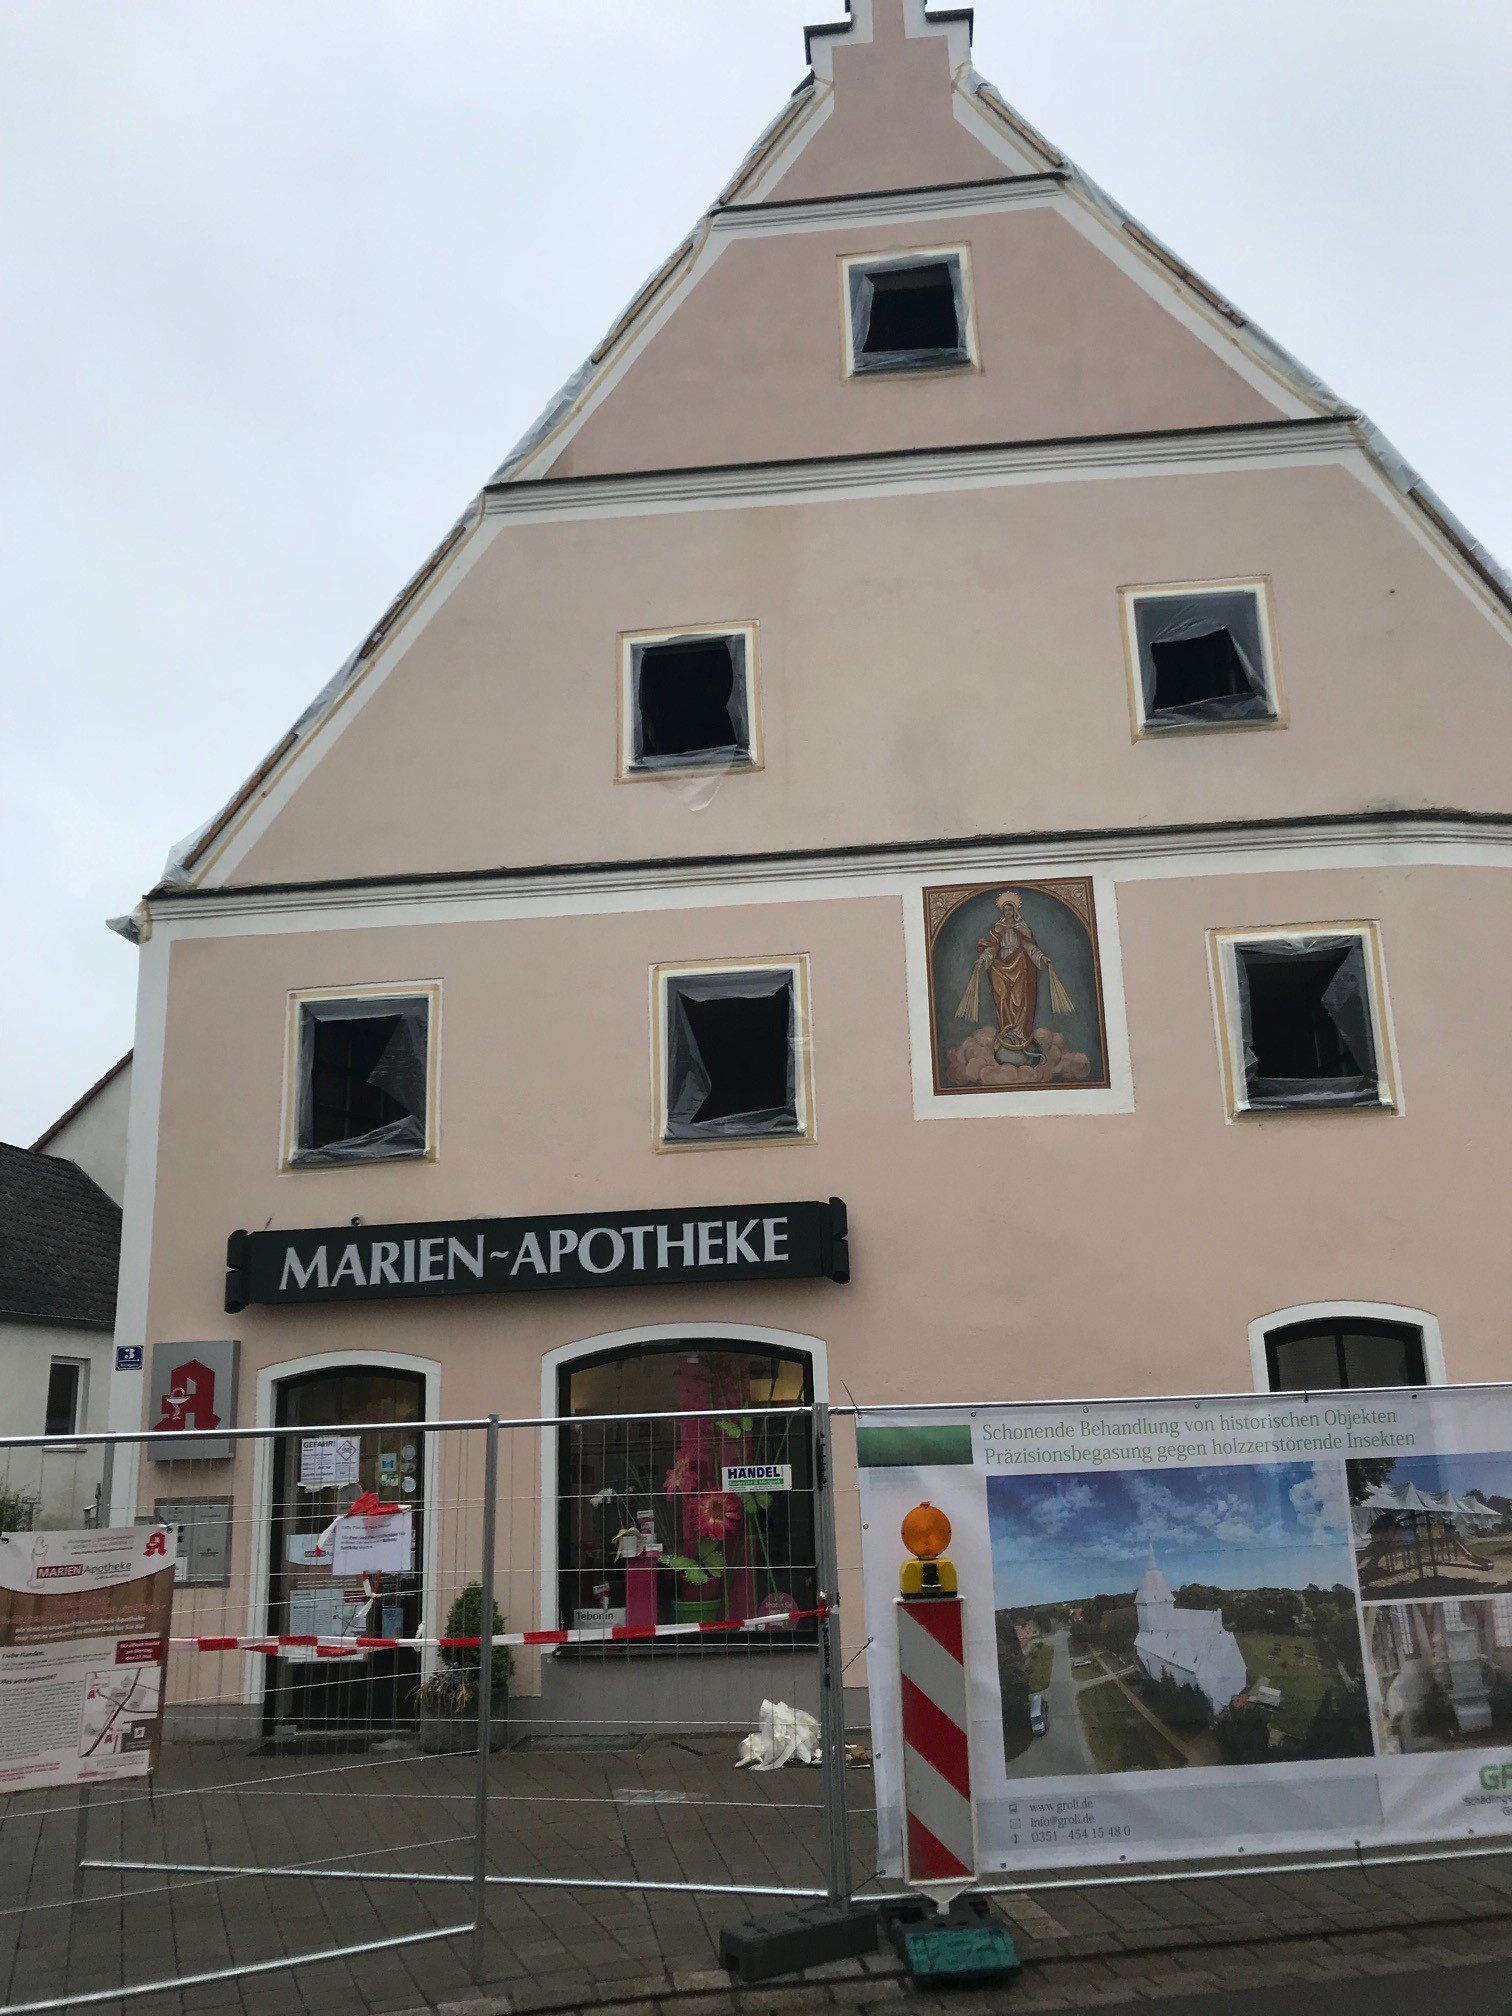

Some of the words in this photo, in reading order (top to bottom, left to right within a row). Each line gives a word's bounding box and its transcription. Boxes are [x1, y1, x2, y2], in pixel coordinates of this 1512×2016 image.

[124, 1348, 135, 1359] 3
[983, 1422, 1074, 1441] Schonende
[1080, 1418, 1180, 1438] Behandlung
[1185, 1418, 1214, 1432] von
[1219, 1412, 1320, 1431] historischen
[1325, 1410, 1397, 1430] Objekten
[303, 1440, 336, 1448] GEFAHR!
[985, 1445, 1152, 1466] Präzisionsbegasung
[1157, 1442, 1207, 1462] gegen
[1212, 1433, 1342, 1456] holzzerstörende
[1347, 1431, 1416, 1449] Insekten
[728, 1466, 780, 1480] HÄNDEL
[38, 1566, 83, 1577] MARIEN
[84, 1562, 132, 1575] Apotheke
[576, 1611, 614, 1621] Tebonin
[1029, 1798, 1094, 1813] www.groli.de
[1030, 1813, 1095, 1828] info@groli.de
[1031, 1830, 1058, 1843] 0351
[1068, 1829, 1088, 1840] 454
[1092, 1827, 1104, 1839] 15
